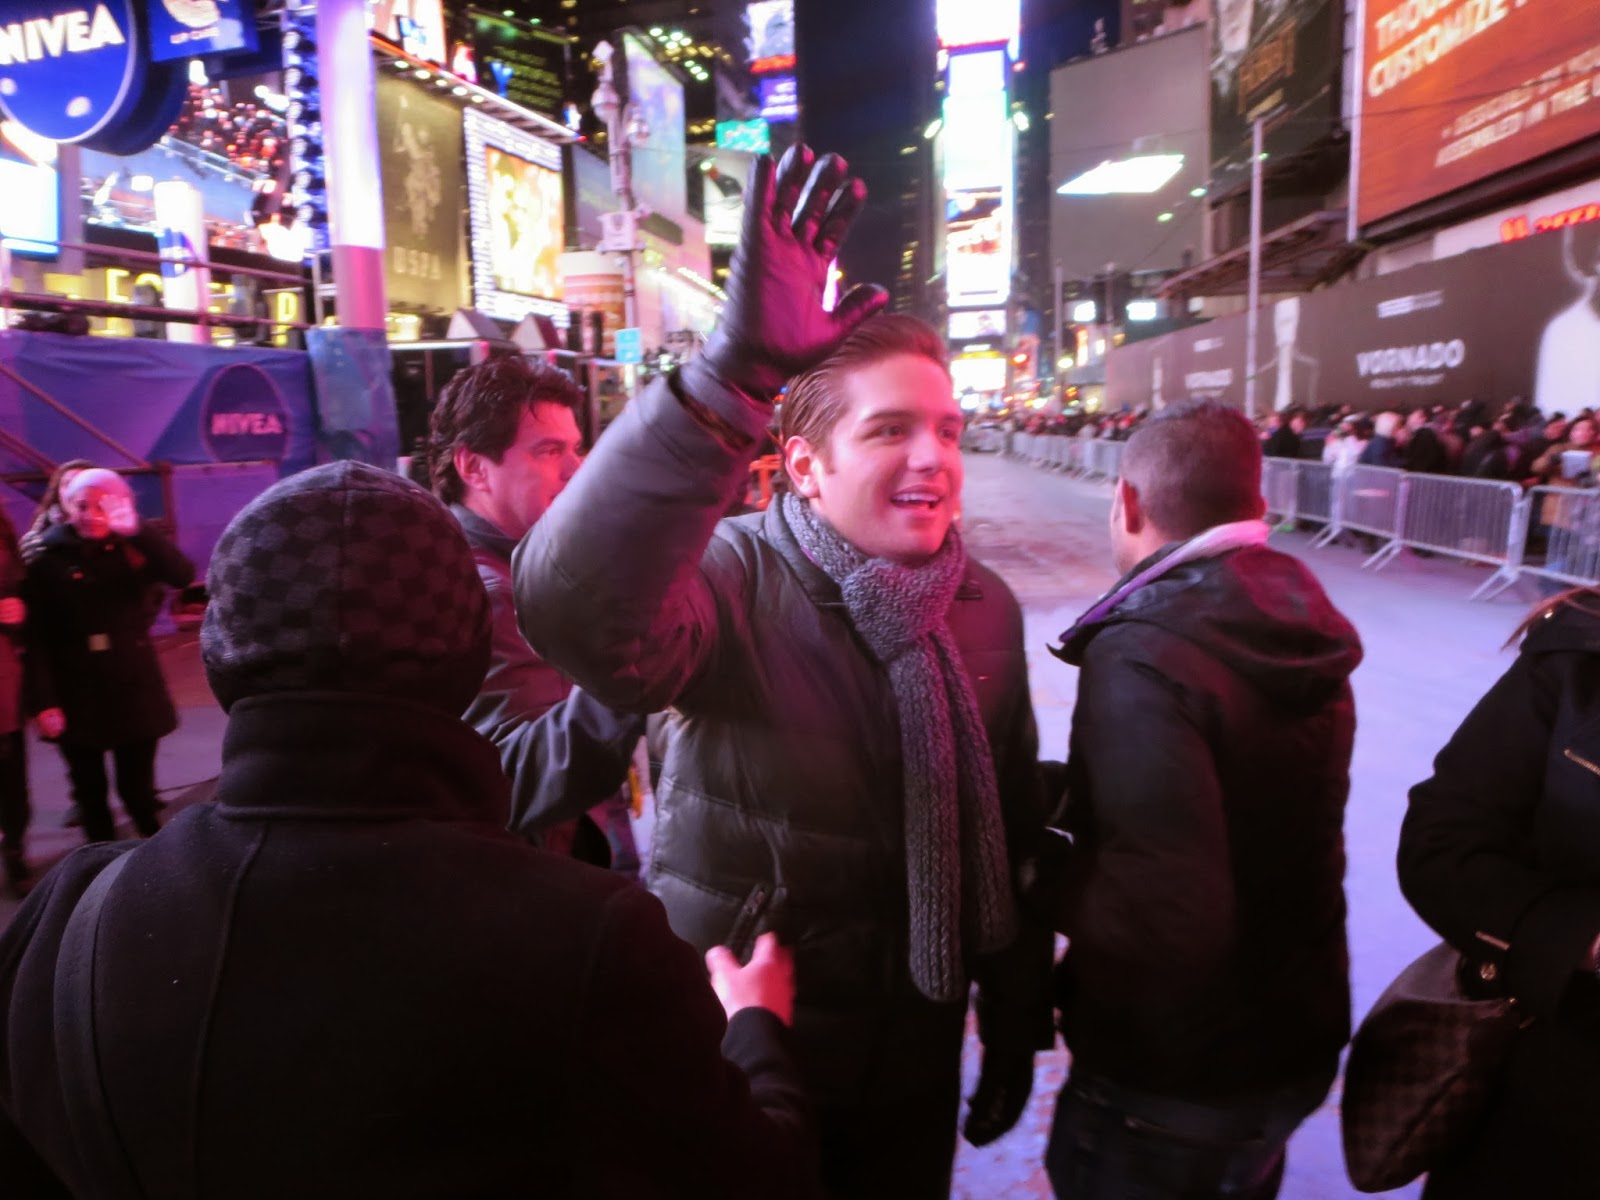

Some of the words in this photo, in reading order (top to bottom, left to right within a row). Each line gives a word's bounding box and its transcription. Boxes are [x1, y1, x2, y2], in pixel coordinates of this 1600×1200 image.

[0, 3, 126, 65] NIVEA
[1356, 339, 1465, 377] VORNADO
[211, 412, 284, 435] NIVEA
